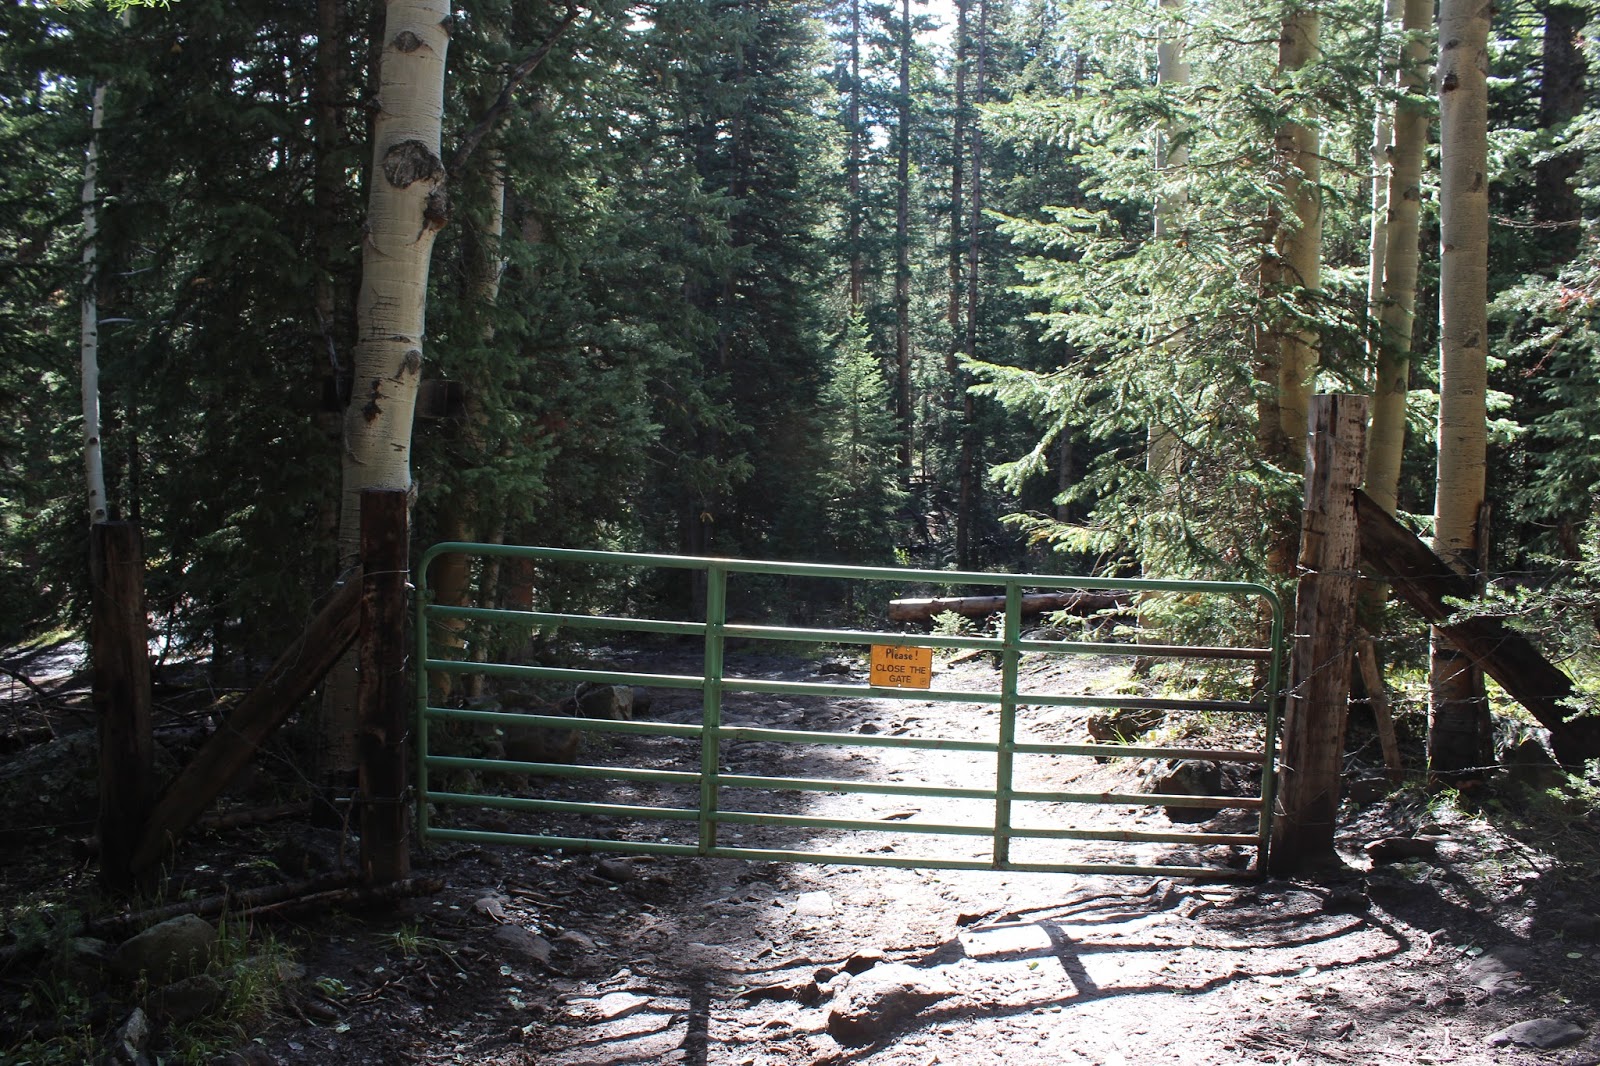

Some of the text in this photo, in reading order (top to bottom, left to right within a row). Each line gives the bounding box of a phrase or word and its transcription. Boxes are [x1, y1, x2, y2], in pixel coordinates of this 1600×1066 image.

[875, 664, 926, 674] CLOSE THE
[889, 675, 912, 683] GATE
